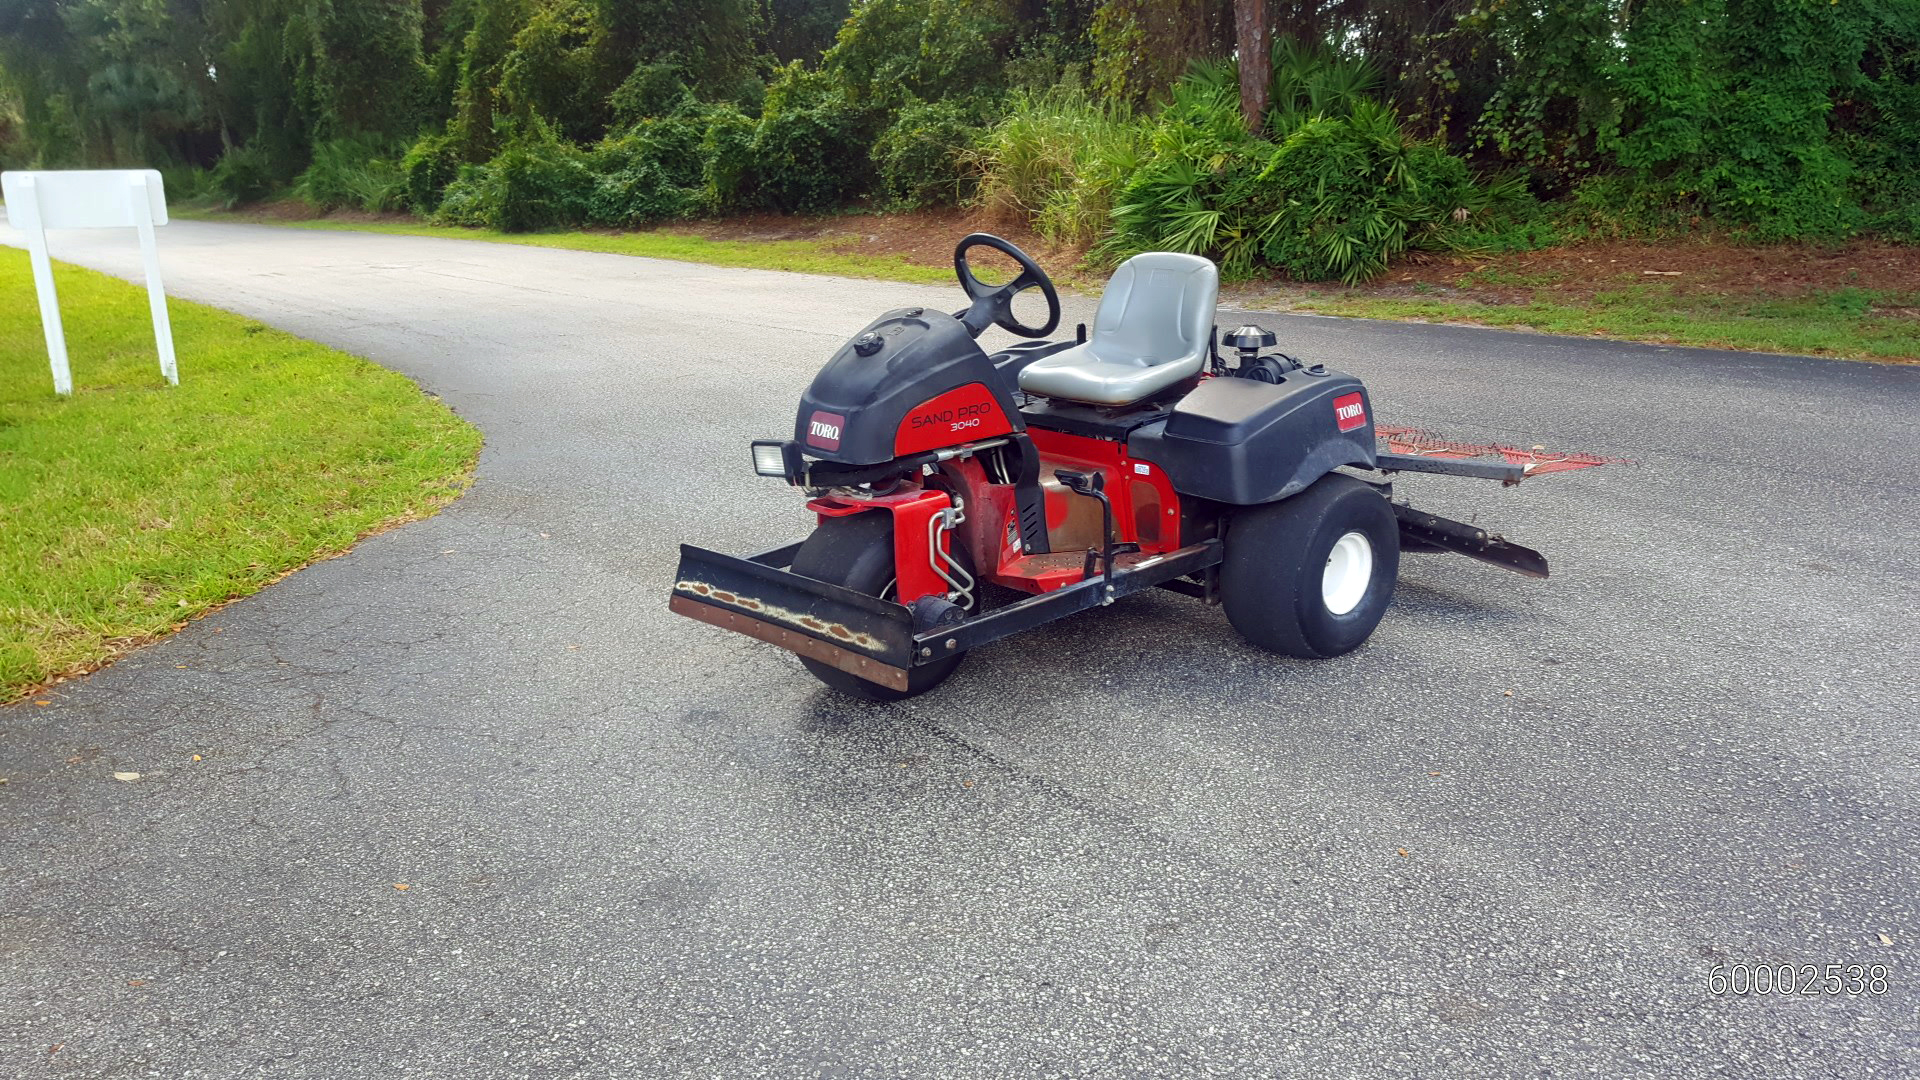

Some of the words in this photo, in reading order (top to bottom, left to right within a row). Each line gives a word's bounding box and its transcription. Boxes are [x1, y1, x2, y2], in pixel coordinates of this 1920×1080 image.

[911, 410, 954, 429] SAND
[958, 402, 991, 419] PRO
[950, 418, 980, 432] 3040
